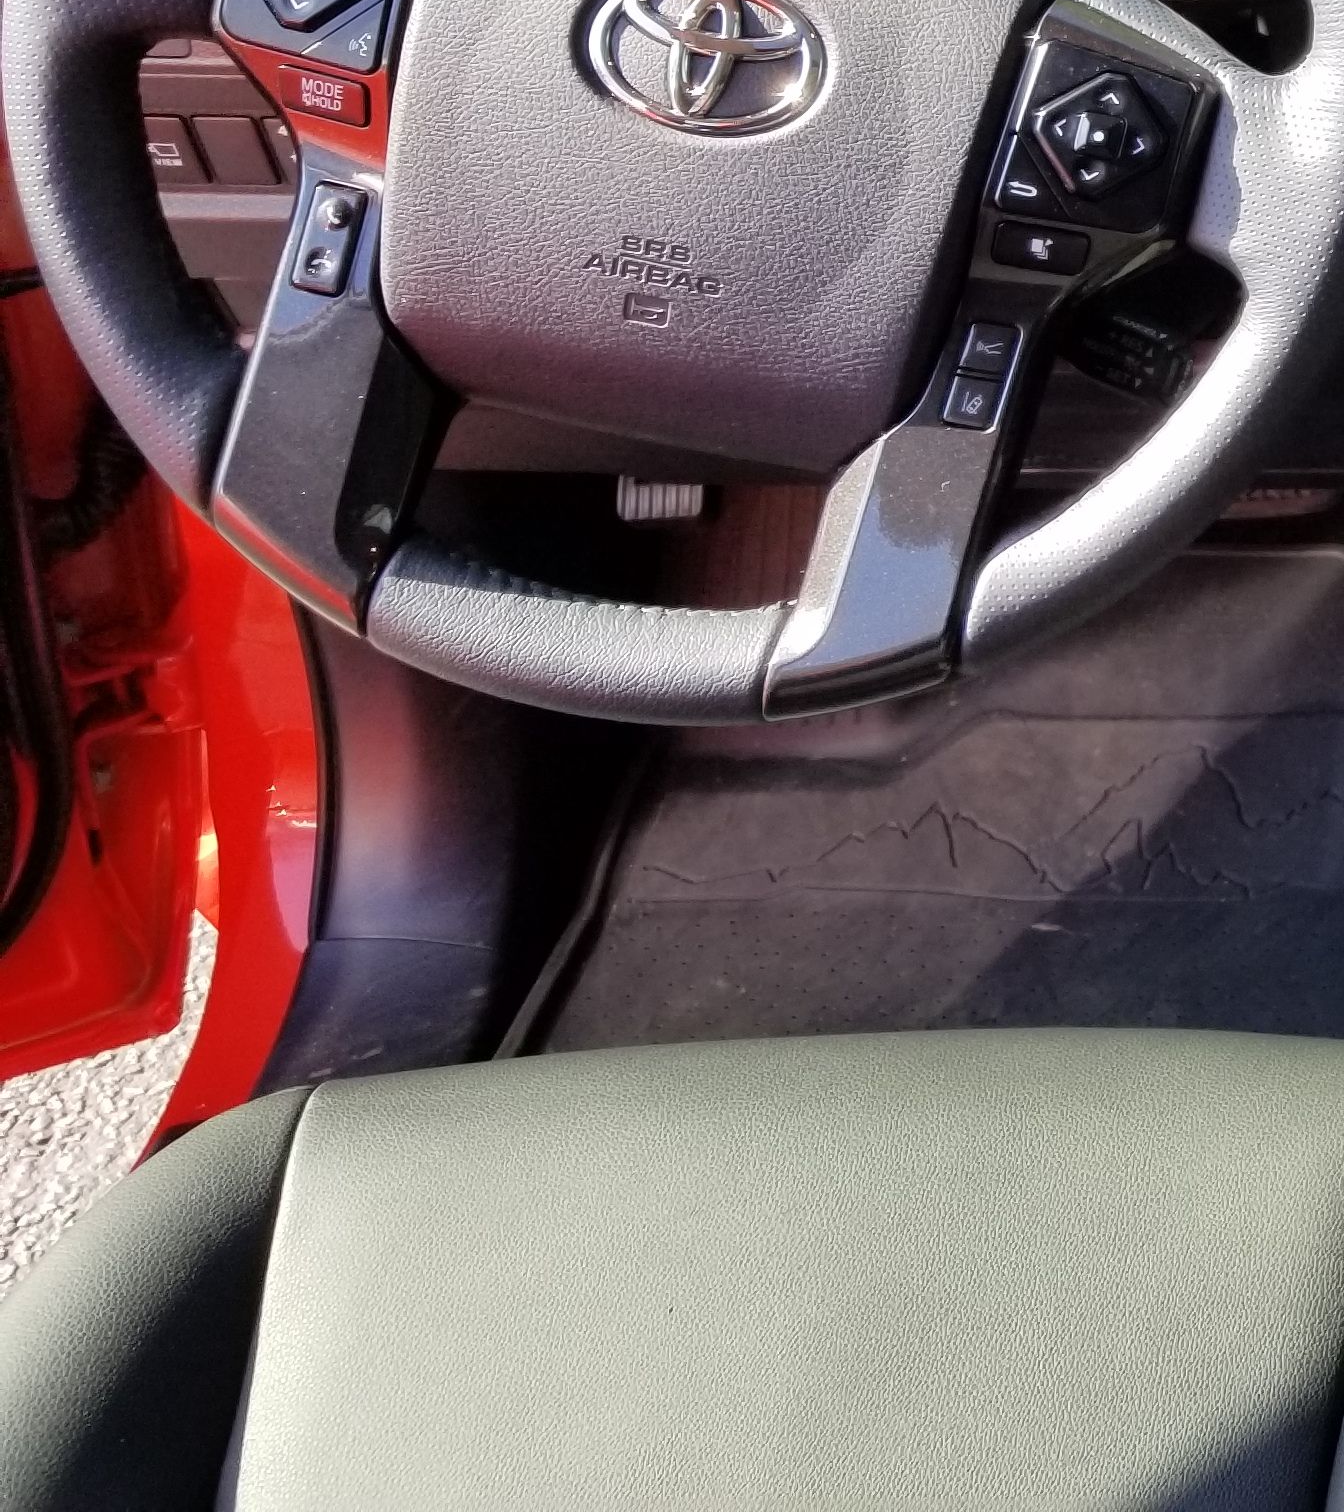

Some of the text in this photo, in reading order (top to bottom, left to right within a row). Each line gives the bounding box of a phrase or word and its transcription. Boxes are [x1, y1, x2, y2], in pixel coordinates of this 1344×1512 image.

[301, 77, 344, 99] MODE
[310, 96, 342, 111] HOLD
[583, 253, 723, 298] AIRBAG
